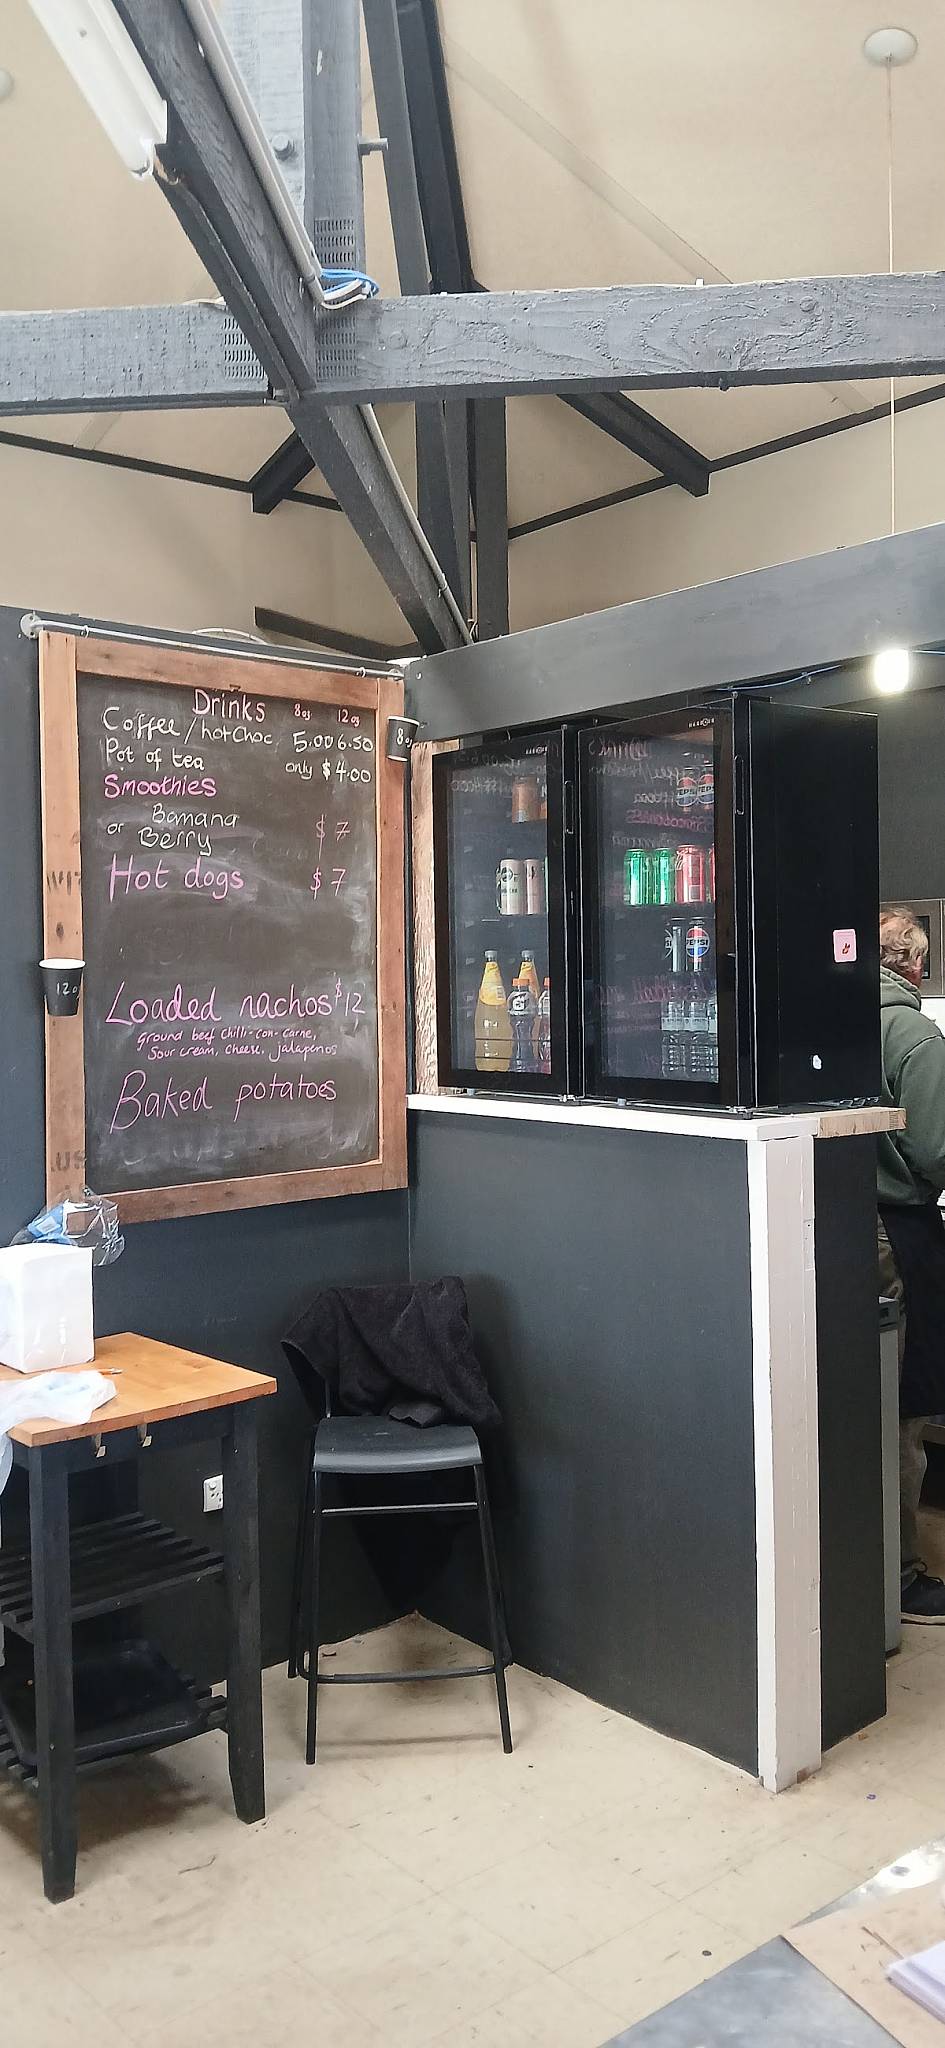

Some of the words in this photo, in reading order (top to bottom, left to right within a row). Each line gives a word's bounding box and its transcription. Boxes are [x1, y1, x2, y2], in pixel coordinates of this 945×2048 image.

[192, 689, 265, 722] Drinks
[103, 706, 180, 741] Coffee
[293, 730, 333, 752] 5.00
[337, 734, 373, 752] 6.50
[106, 737, 134, 767] Pot
[146, 748, 162, 772] of
[172, 748, 205, 771] tea
[286, 760, 312, 780] only
[104, 773, 217, 799] Smoothies
[107, 822, 125, 835] or
[138, 826, 212, 857] Berry
[108, 853, 170, 903] Hot
[183, 855, 245, 900] dogs
[105, 981, 222, 1026] Loaded
[239, 984, 333, 1019] nachos
[192, 1027, 215, 1045] beef
[268, 1039, 338, 1063] jalapenos
[109, 1069, 213, 1135] Baked
[233, 1072, 338, 1123] potatoes
